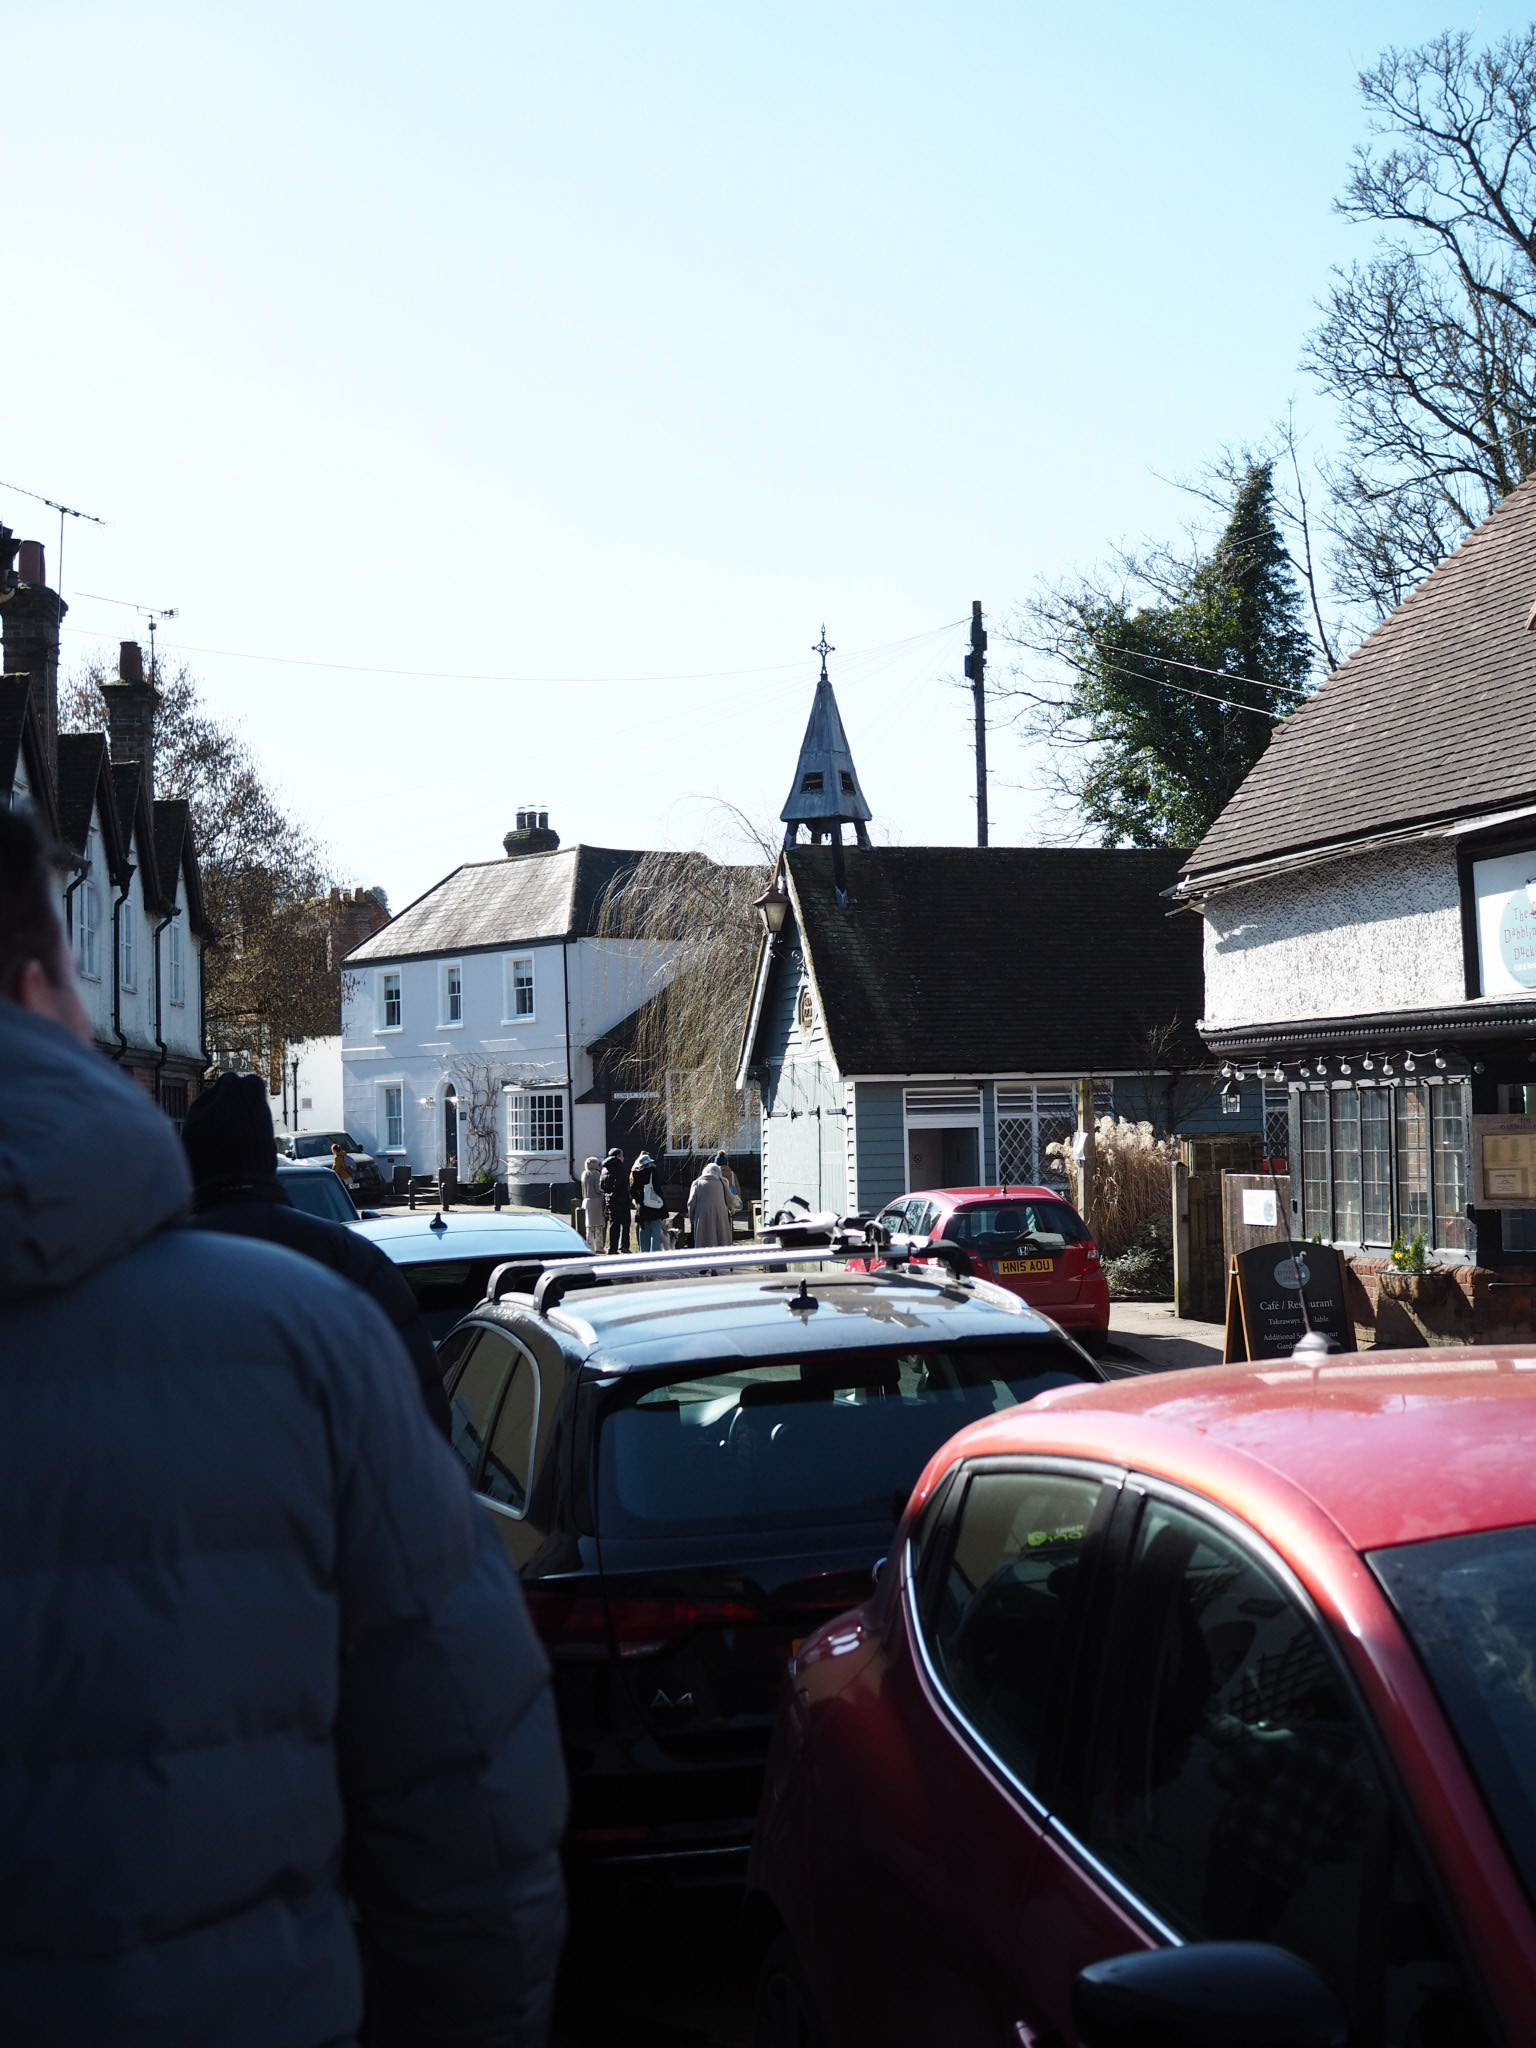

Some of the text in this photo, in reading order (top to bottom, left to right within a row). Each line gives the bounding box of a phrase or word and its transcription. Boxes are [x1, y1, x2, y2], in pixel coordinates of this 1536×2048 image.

[1514, 907, 1528, 922] The
[1513, 945, 1535, 961] Duck
[1002, 1260, 1050, 1273] HN15 AOU
[1259, 1301, 1280, 1311] Café
[1287, 1299, 1333, 1309] Resurant
[1269, 1317, 1300, 1325] Takeaways
[1263, 1333, 1295, 1341] Additional
[650, 1688, 695, 1709] A4
